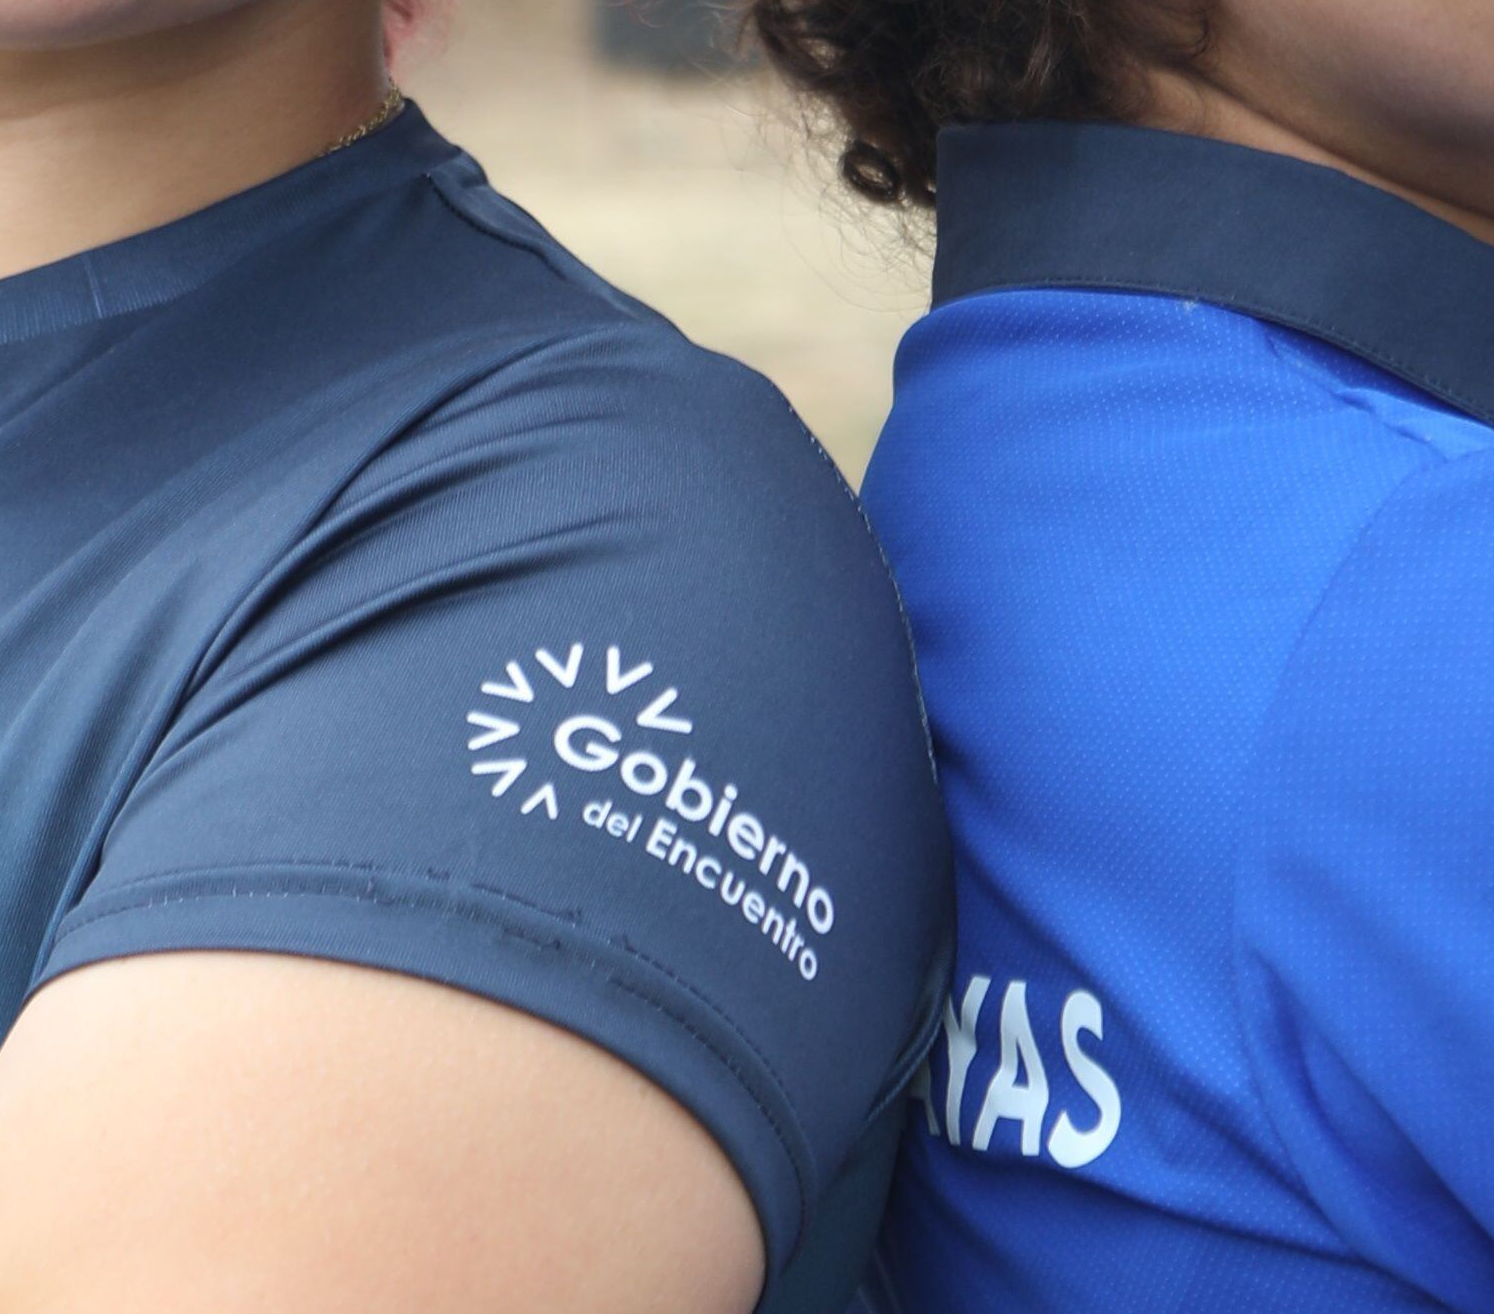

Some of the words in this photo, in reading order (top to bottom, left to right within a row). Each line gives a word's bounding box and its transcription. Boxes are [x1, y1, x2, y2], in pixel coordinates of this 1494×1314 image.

[552, 714, 835, 935] Gobierno
[581, 798, 643, 843] del
[644, 817, 819, 981] Encuentro
